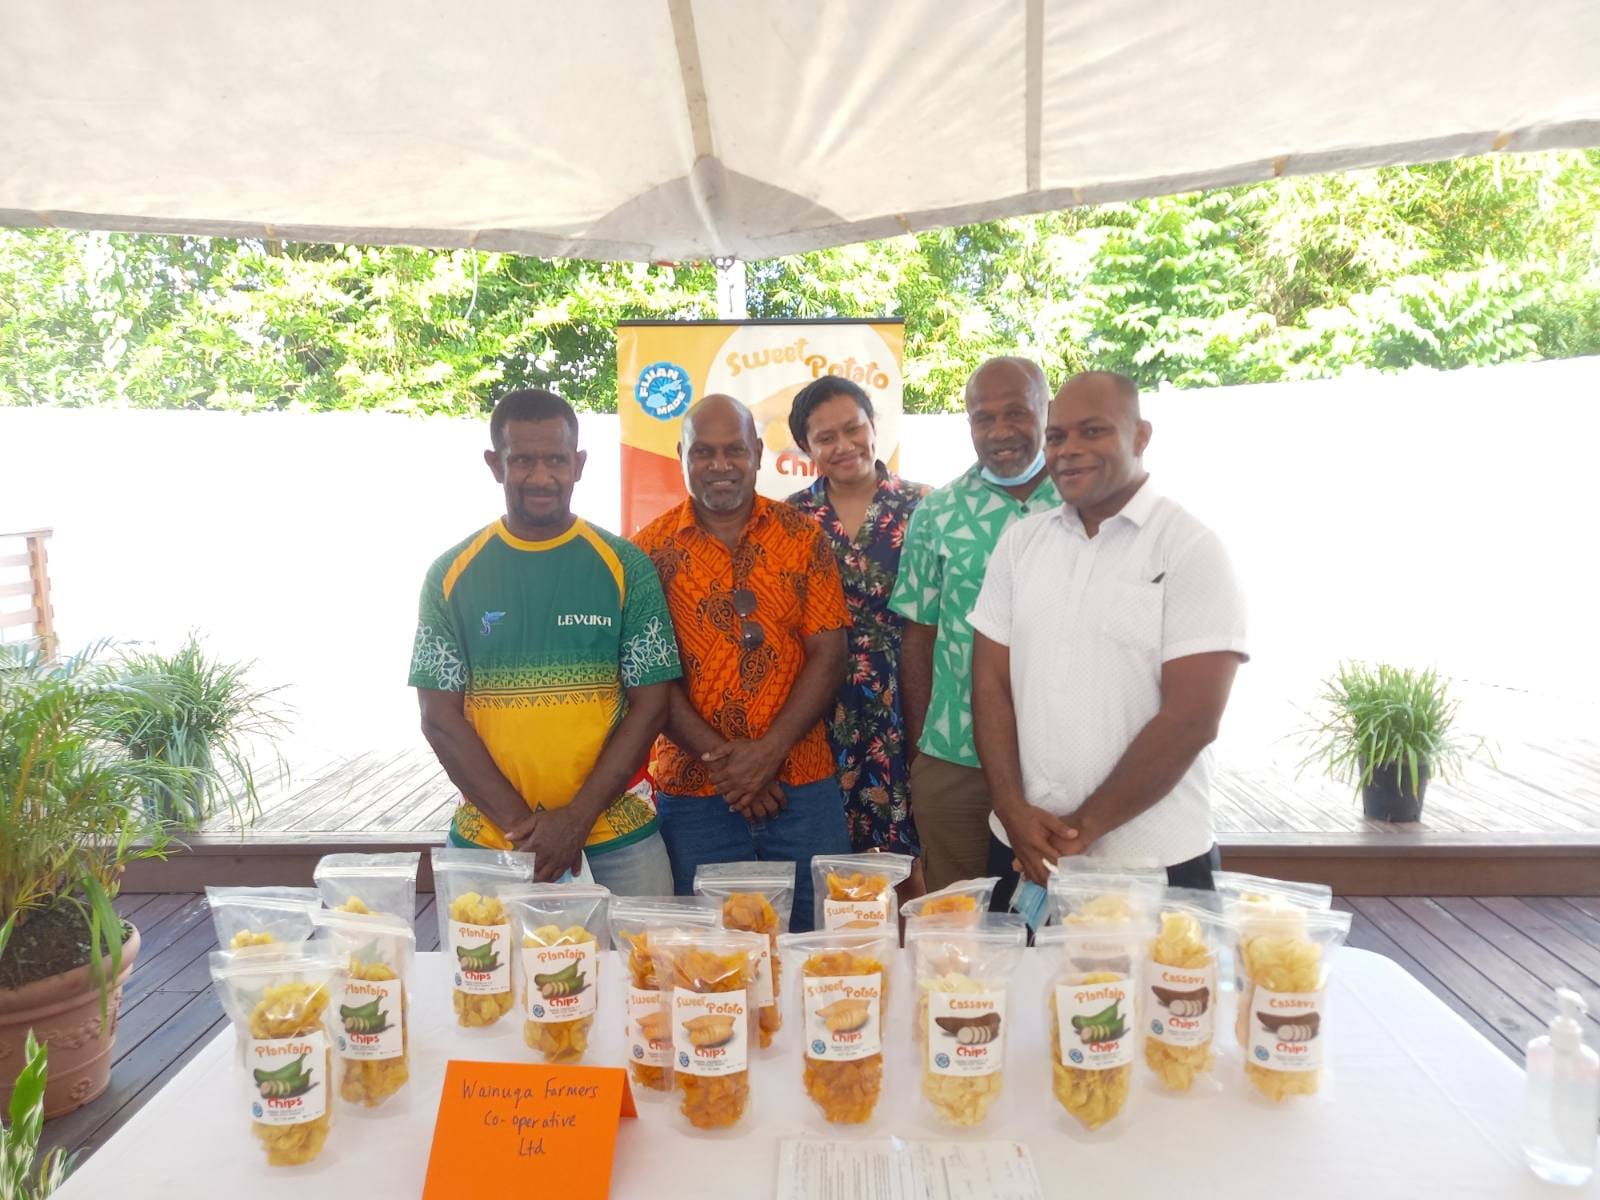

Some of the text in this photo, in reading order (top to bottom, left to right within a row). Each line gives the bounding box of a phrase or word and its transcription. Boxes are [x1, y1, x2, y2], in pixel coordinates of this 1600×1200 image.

[725, 337, 890, 390] Sweet Potato
[639, 367, 680, 398] FIJIAN
[656, 391, 686, 415] MADE
[775, 452, 823, 477] Chi
[557, 613, 612, 628] LEVUKA
[826, 904, 885, 920] Sweet Potato
[458, 927, 501, 941] Plantain
[537, 949, 586, 963] Plantain
[464, 970, 492, 982] Chips
[807, 979, 878, 998] Sweet Potato
[1074, 987, 1126, 1003] Plantain
[548, 994, 580, 1008] Chips
[676, 995, 744, 1016] Sweet Potato
[949, 998, 995, 1010] Cassava
[1168, 1016, 1200, 1030] Chips
[350, 1031, 380, 1045] Chips
[831, 1029, 862, 1043] Chips
[255, 1042, 313, 1058] Plantain
[694, 1044, 727, 1059] Chips
[956, 1046, 988, 1059] Chips
[1089, 1040, 1120, 1053] Chips
[1275, 1041, 1308, 1054] Chips
[543, 1076, 599, 1099] Farmers
[267, 1095, 304, 1109] Chips
[518, 1137, 547, 1157] Ltd
